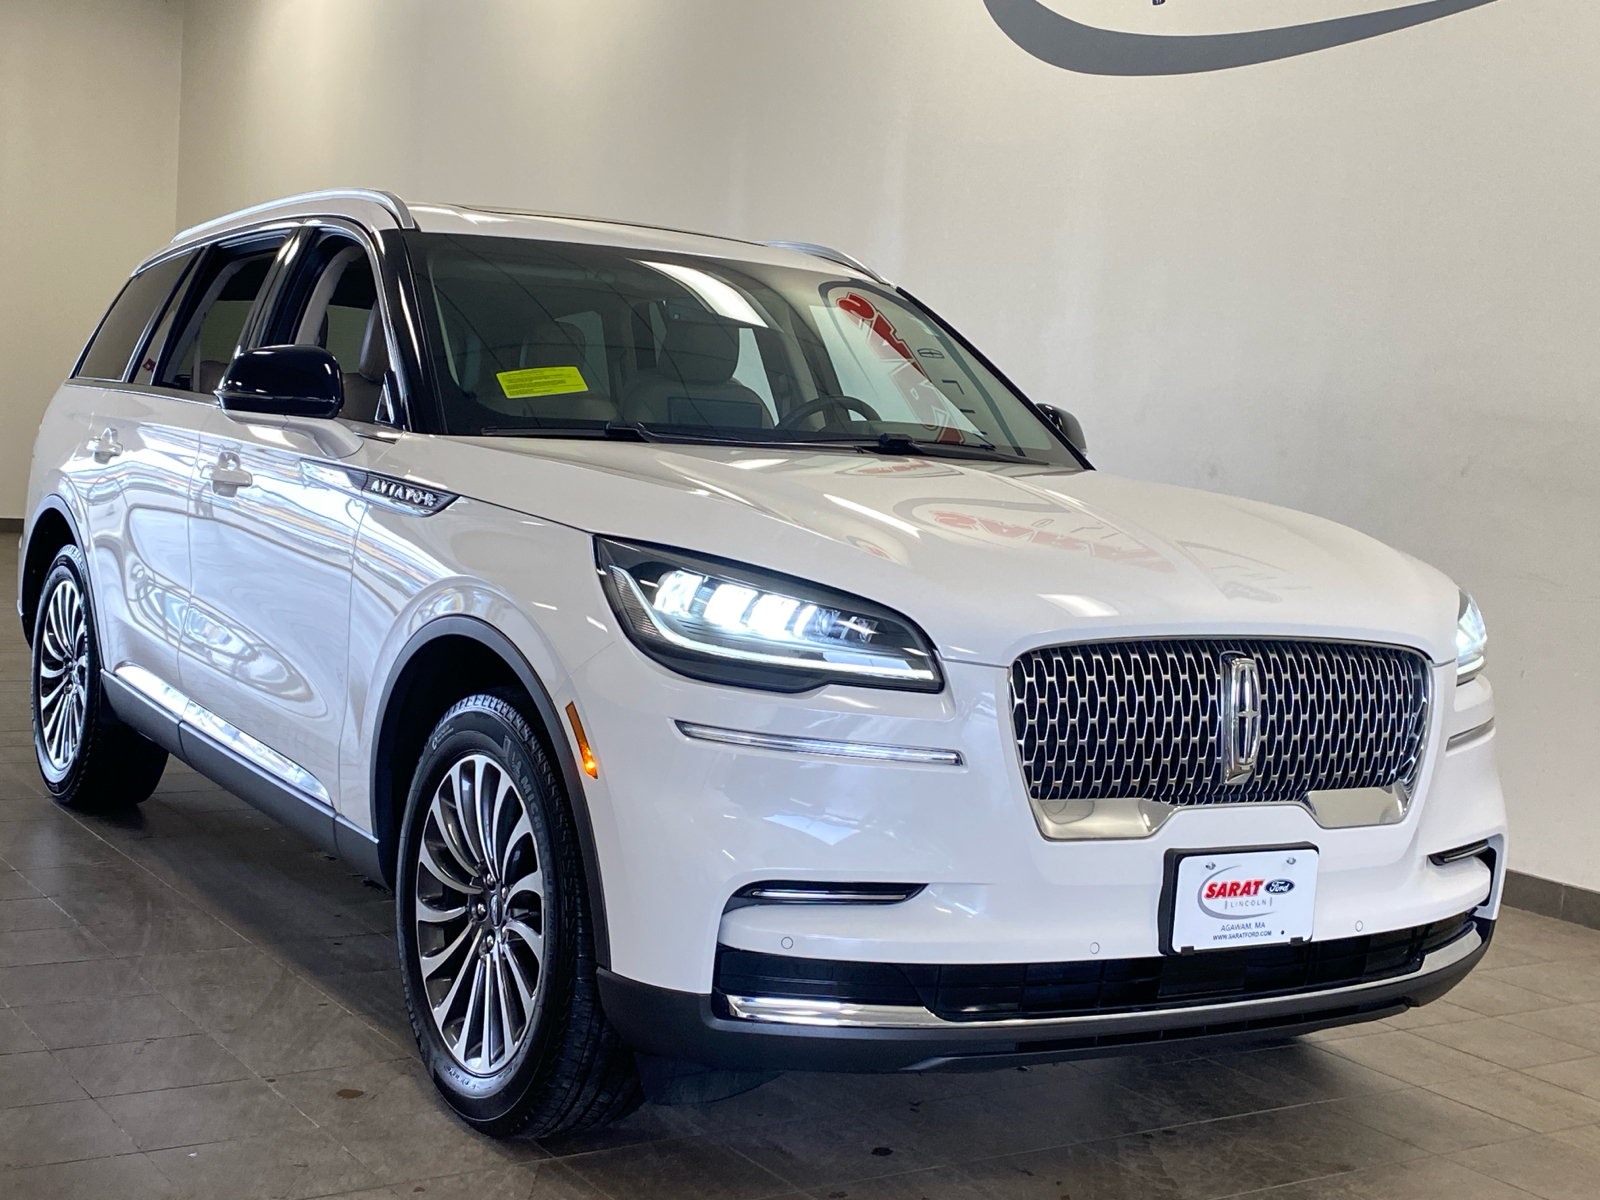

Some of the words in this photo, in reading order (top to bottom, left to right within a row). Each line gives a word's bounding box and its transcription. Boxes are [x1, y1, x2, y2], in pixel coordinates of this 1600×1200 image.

[371, 479, 434, 507] AVIATOR
[1204, 879, 1264, 899] SARAT
[1230, 900, 1267, 908] LINCOLN
[1212, 930, 1272, 940] WWW.SARATFORD.COM
